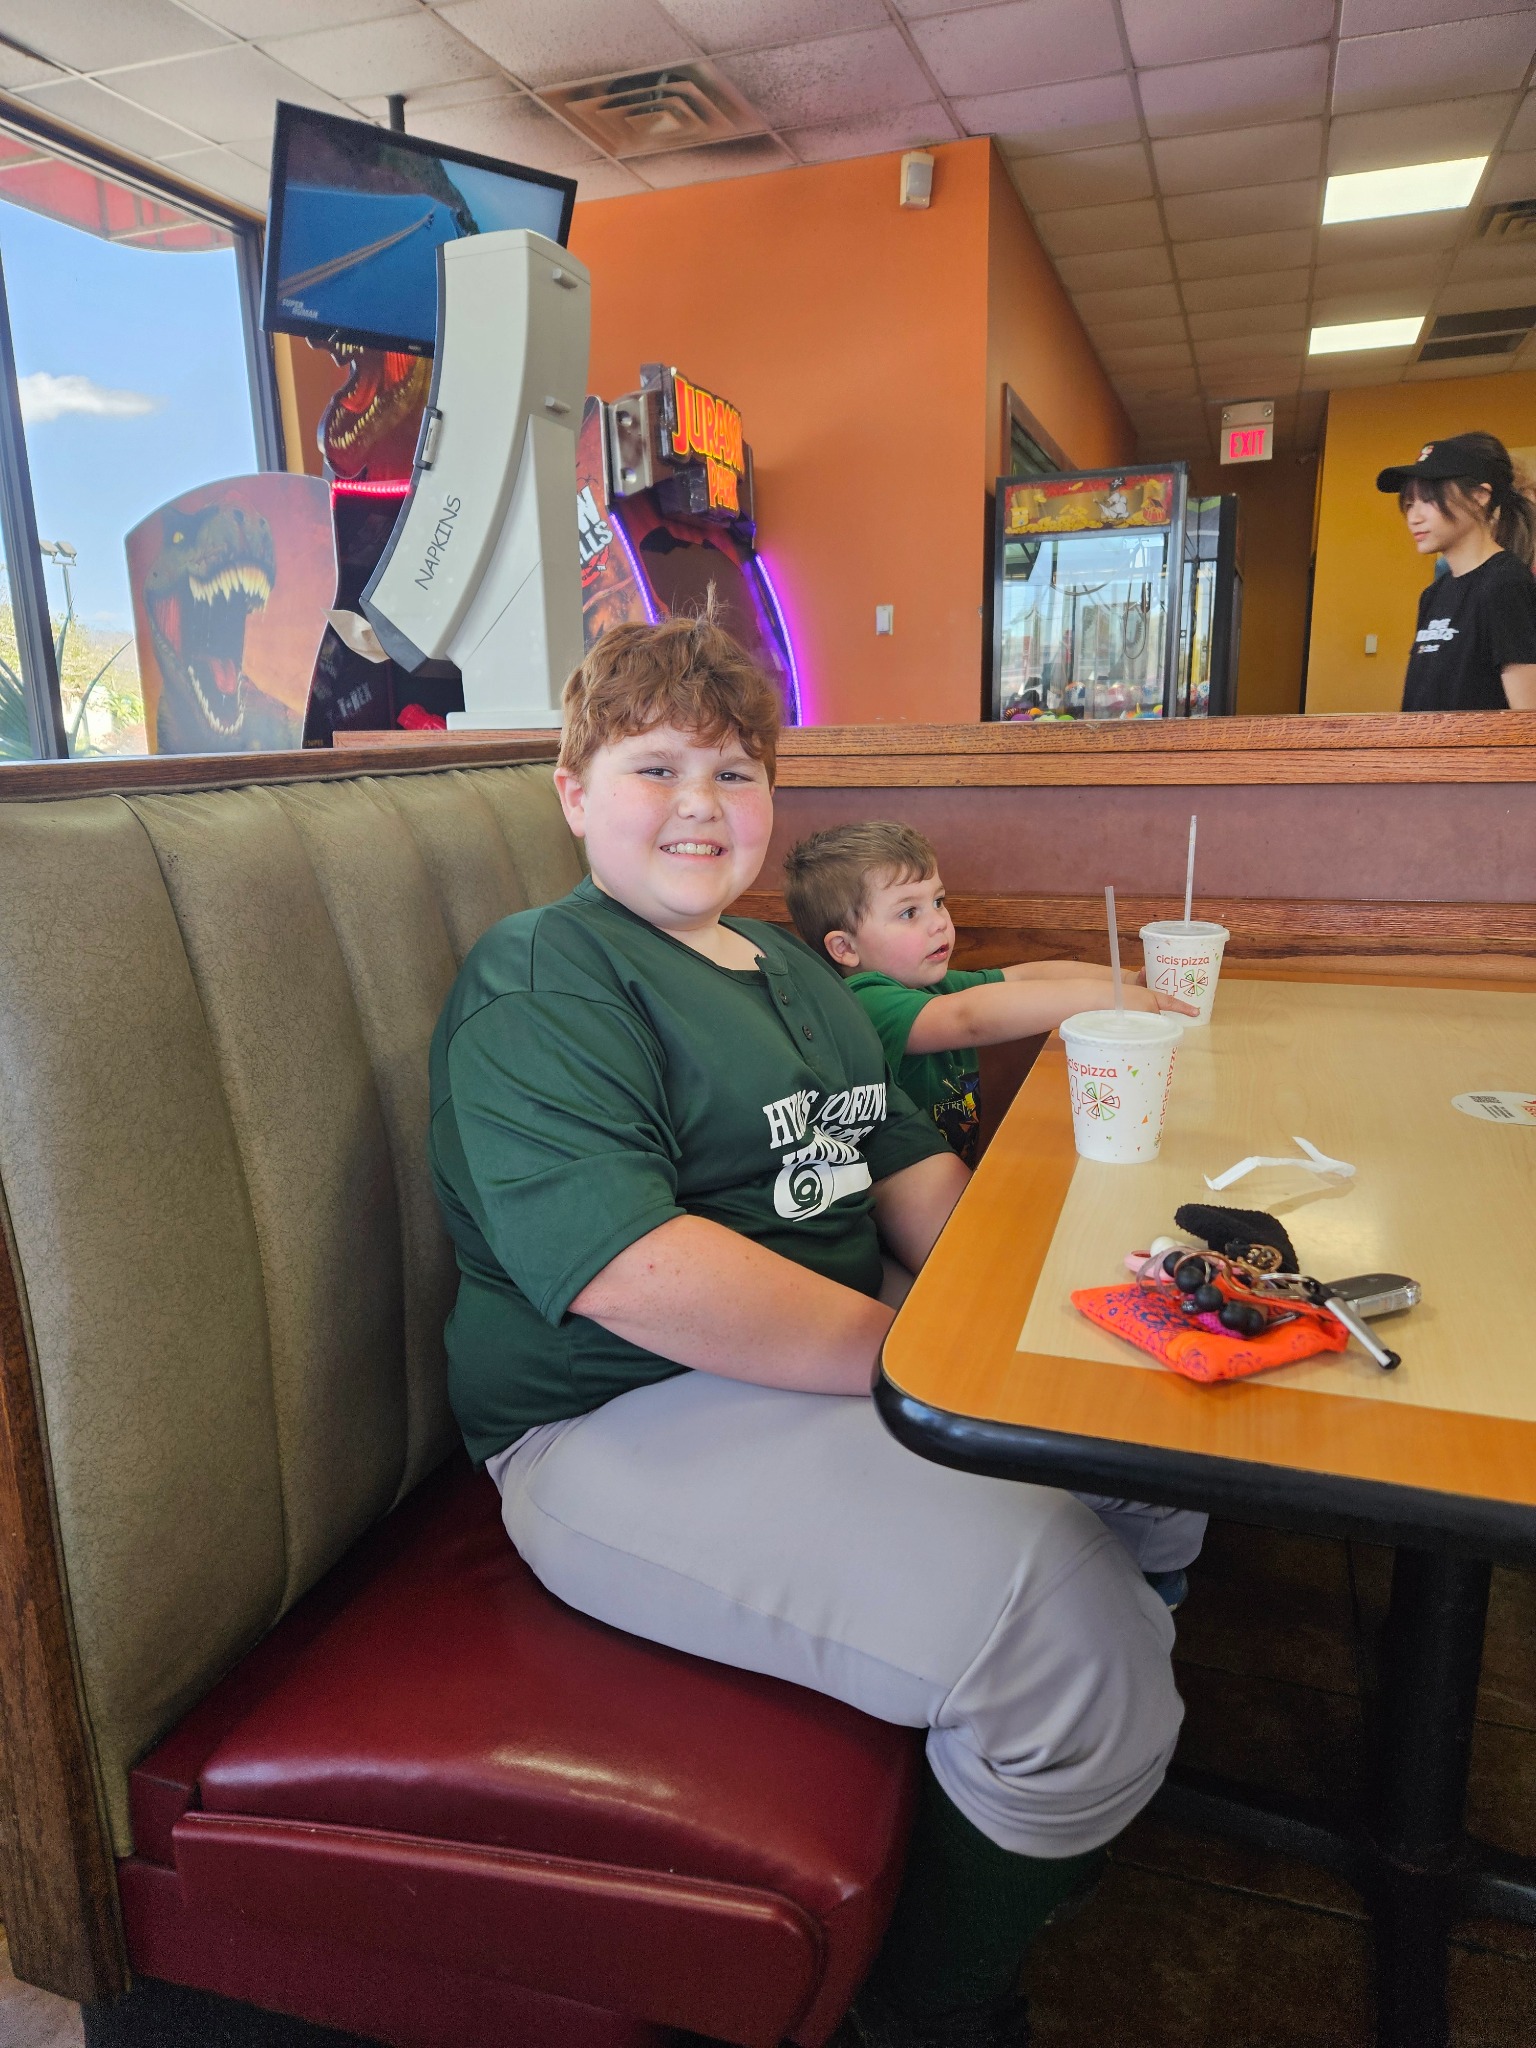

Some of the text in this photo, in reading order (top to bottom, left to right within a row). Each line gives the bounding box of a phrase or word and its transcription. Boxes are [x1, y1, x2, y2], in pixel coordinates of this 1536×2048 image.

[1230, 429, 1266, 459] EXIT
[414, 494, 461, 590] NAPKINS
[1156, 954, 1210, 968] cicis pizza
[1080, 1064, 1118, 1078] pizza
